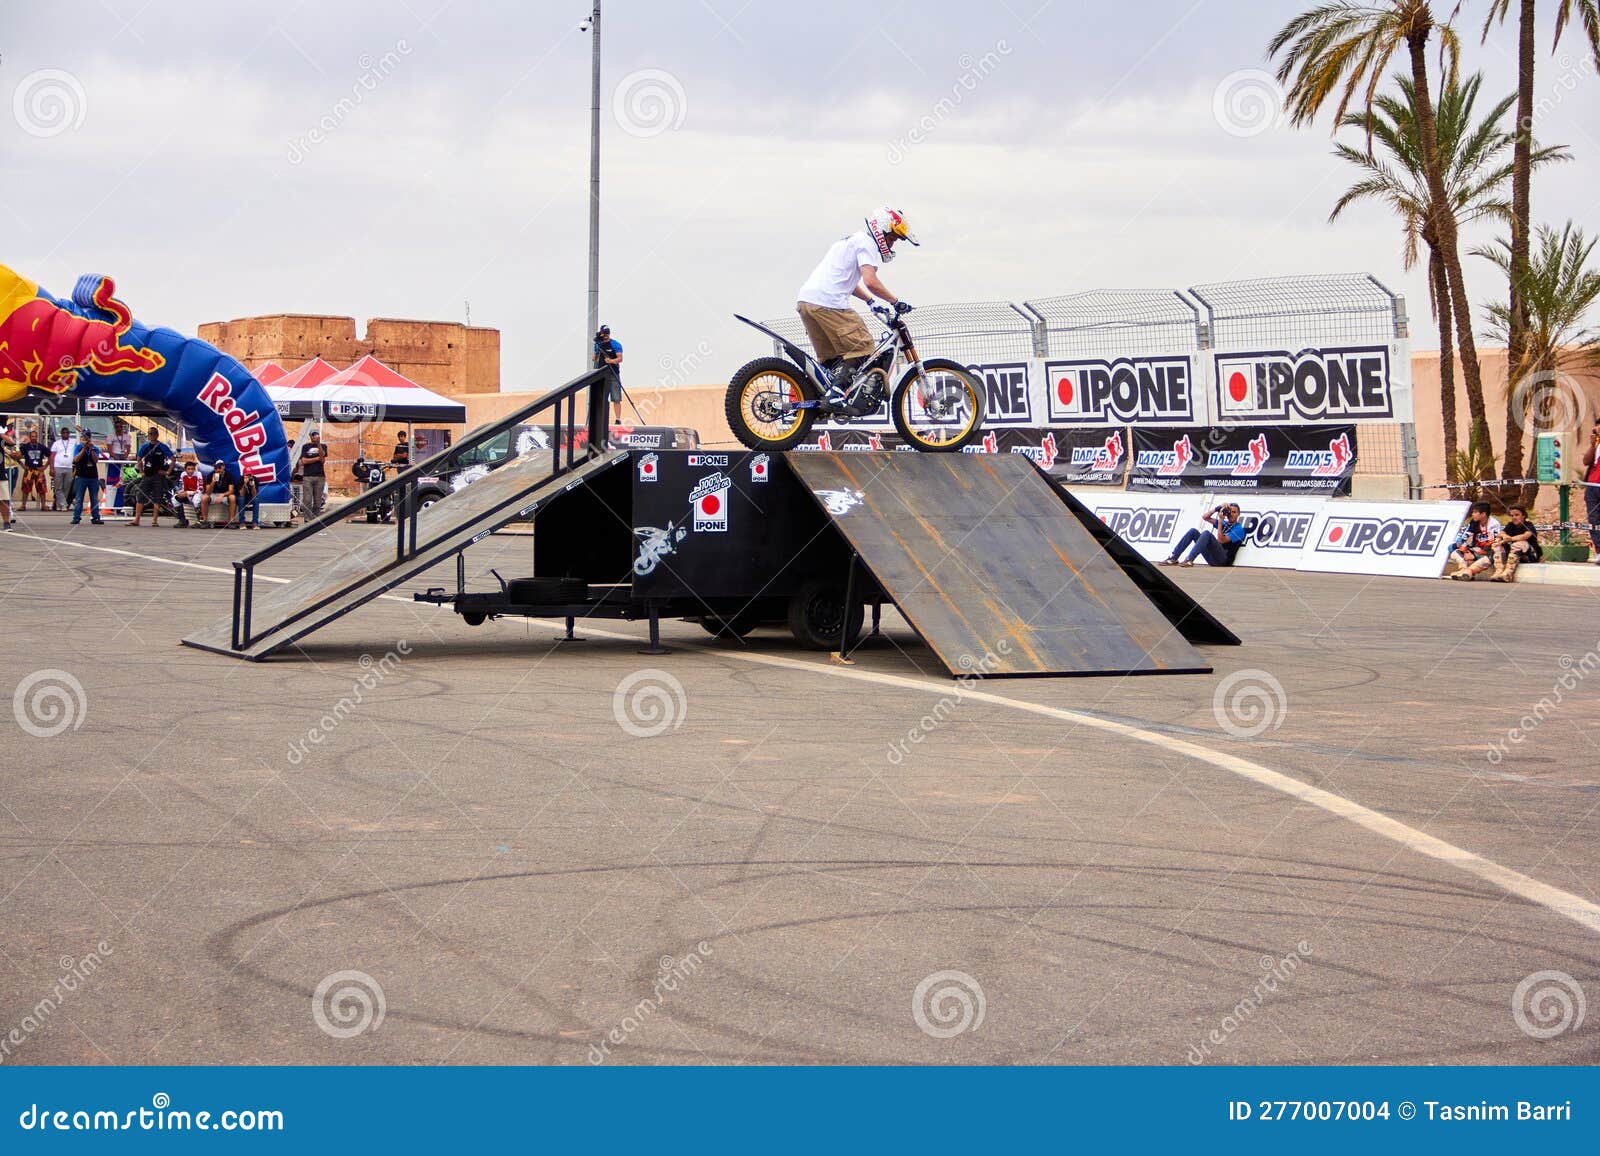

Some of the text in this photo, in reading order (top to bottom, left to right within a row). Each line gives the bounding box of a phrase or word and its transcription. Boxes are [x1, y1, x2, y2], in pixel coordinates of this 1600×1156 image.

[1079, 366, 1188, 413] IPONE
[1255, 358, 1385, 410] IPONE
[934, 371, 1027, 416] IPNE
[97, 401, 131, 411] IPONE
[278, 404, 289, 413] PONE
[340, 404, 375, 414] IPONE
[630, 435, 659, 444] IPONE
[697, 456, 728, 465] IPONE
[1073, 450, 1108, 462] DADA'S
[1138, 453, 1176, 466] DADA'S
[1209, 453, 1251, 466] DADA'S
[1287, 453, 1333, 466] DADA'S
[695, 521, 726, 530] IPONE
[1109, 512, 1176, 538] IPONE
[1238, 516, 1309, 543] PONE
[1345, 523, 1442, 552] IPONE
